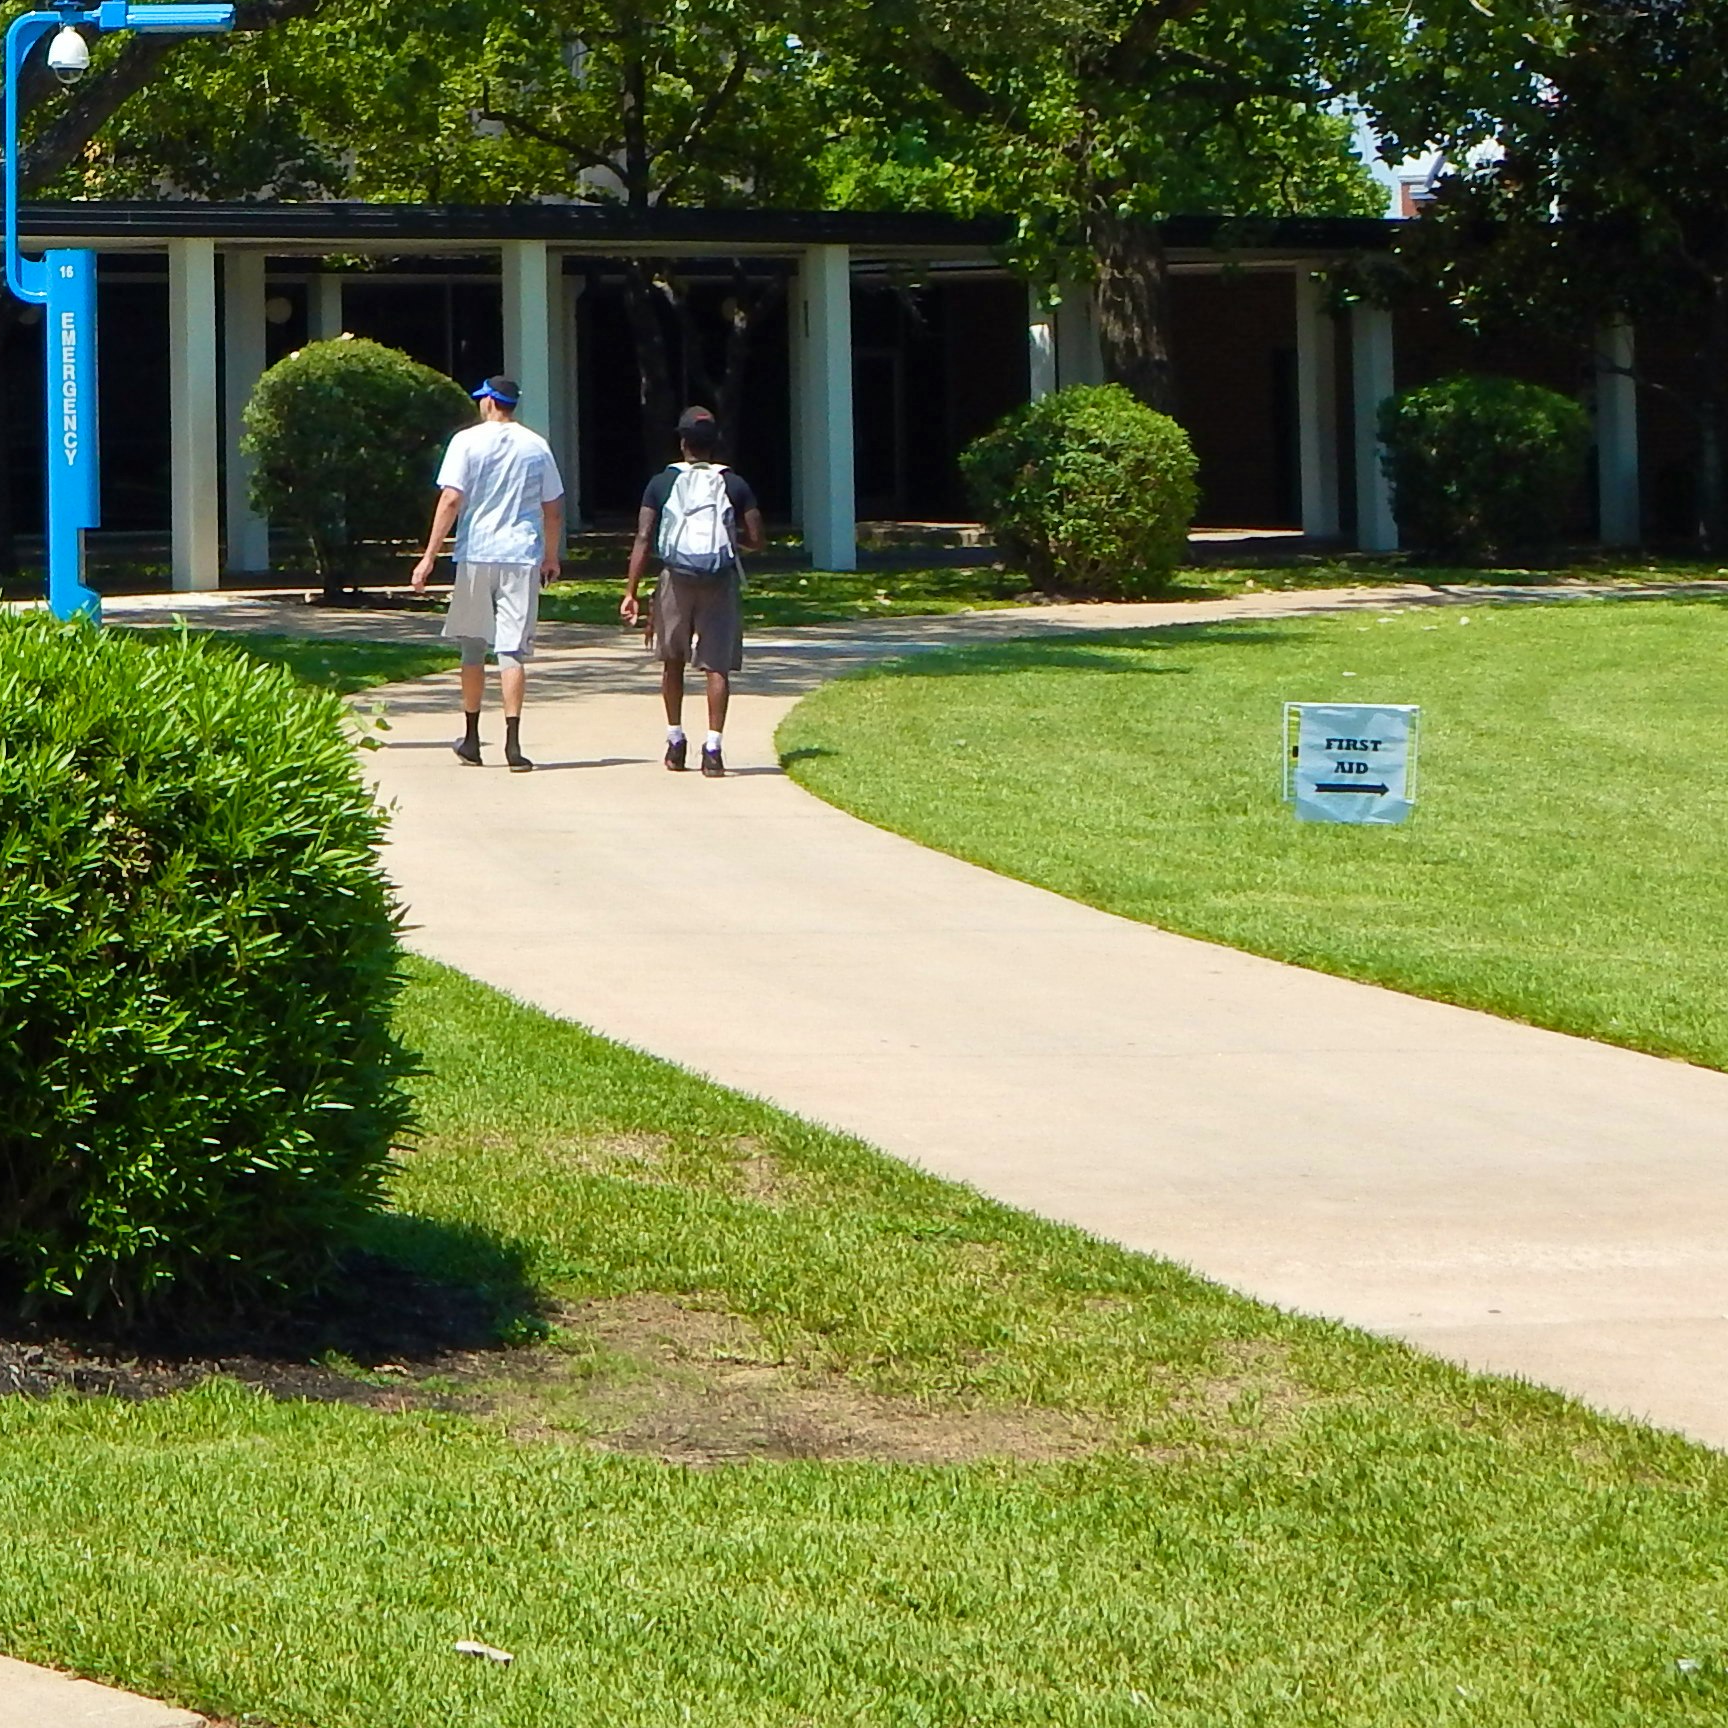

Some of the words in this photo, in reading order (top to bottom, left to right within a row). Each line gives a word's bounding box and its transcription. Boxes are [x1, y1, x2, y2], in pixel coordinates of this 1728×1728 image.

[59, 265, 74, 278] 16
[61, 312, 77, 466] EMERGENCY
[1325, 738, 1382, 751] FIRST
[1334, 761, 1369, 774] AID
